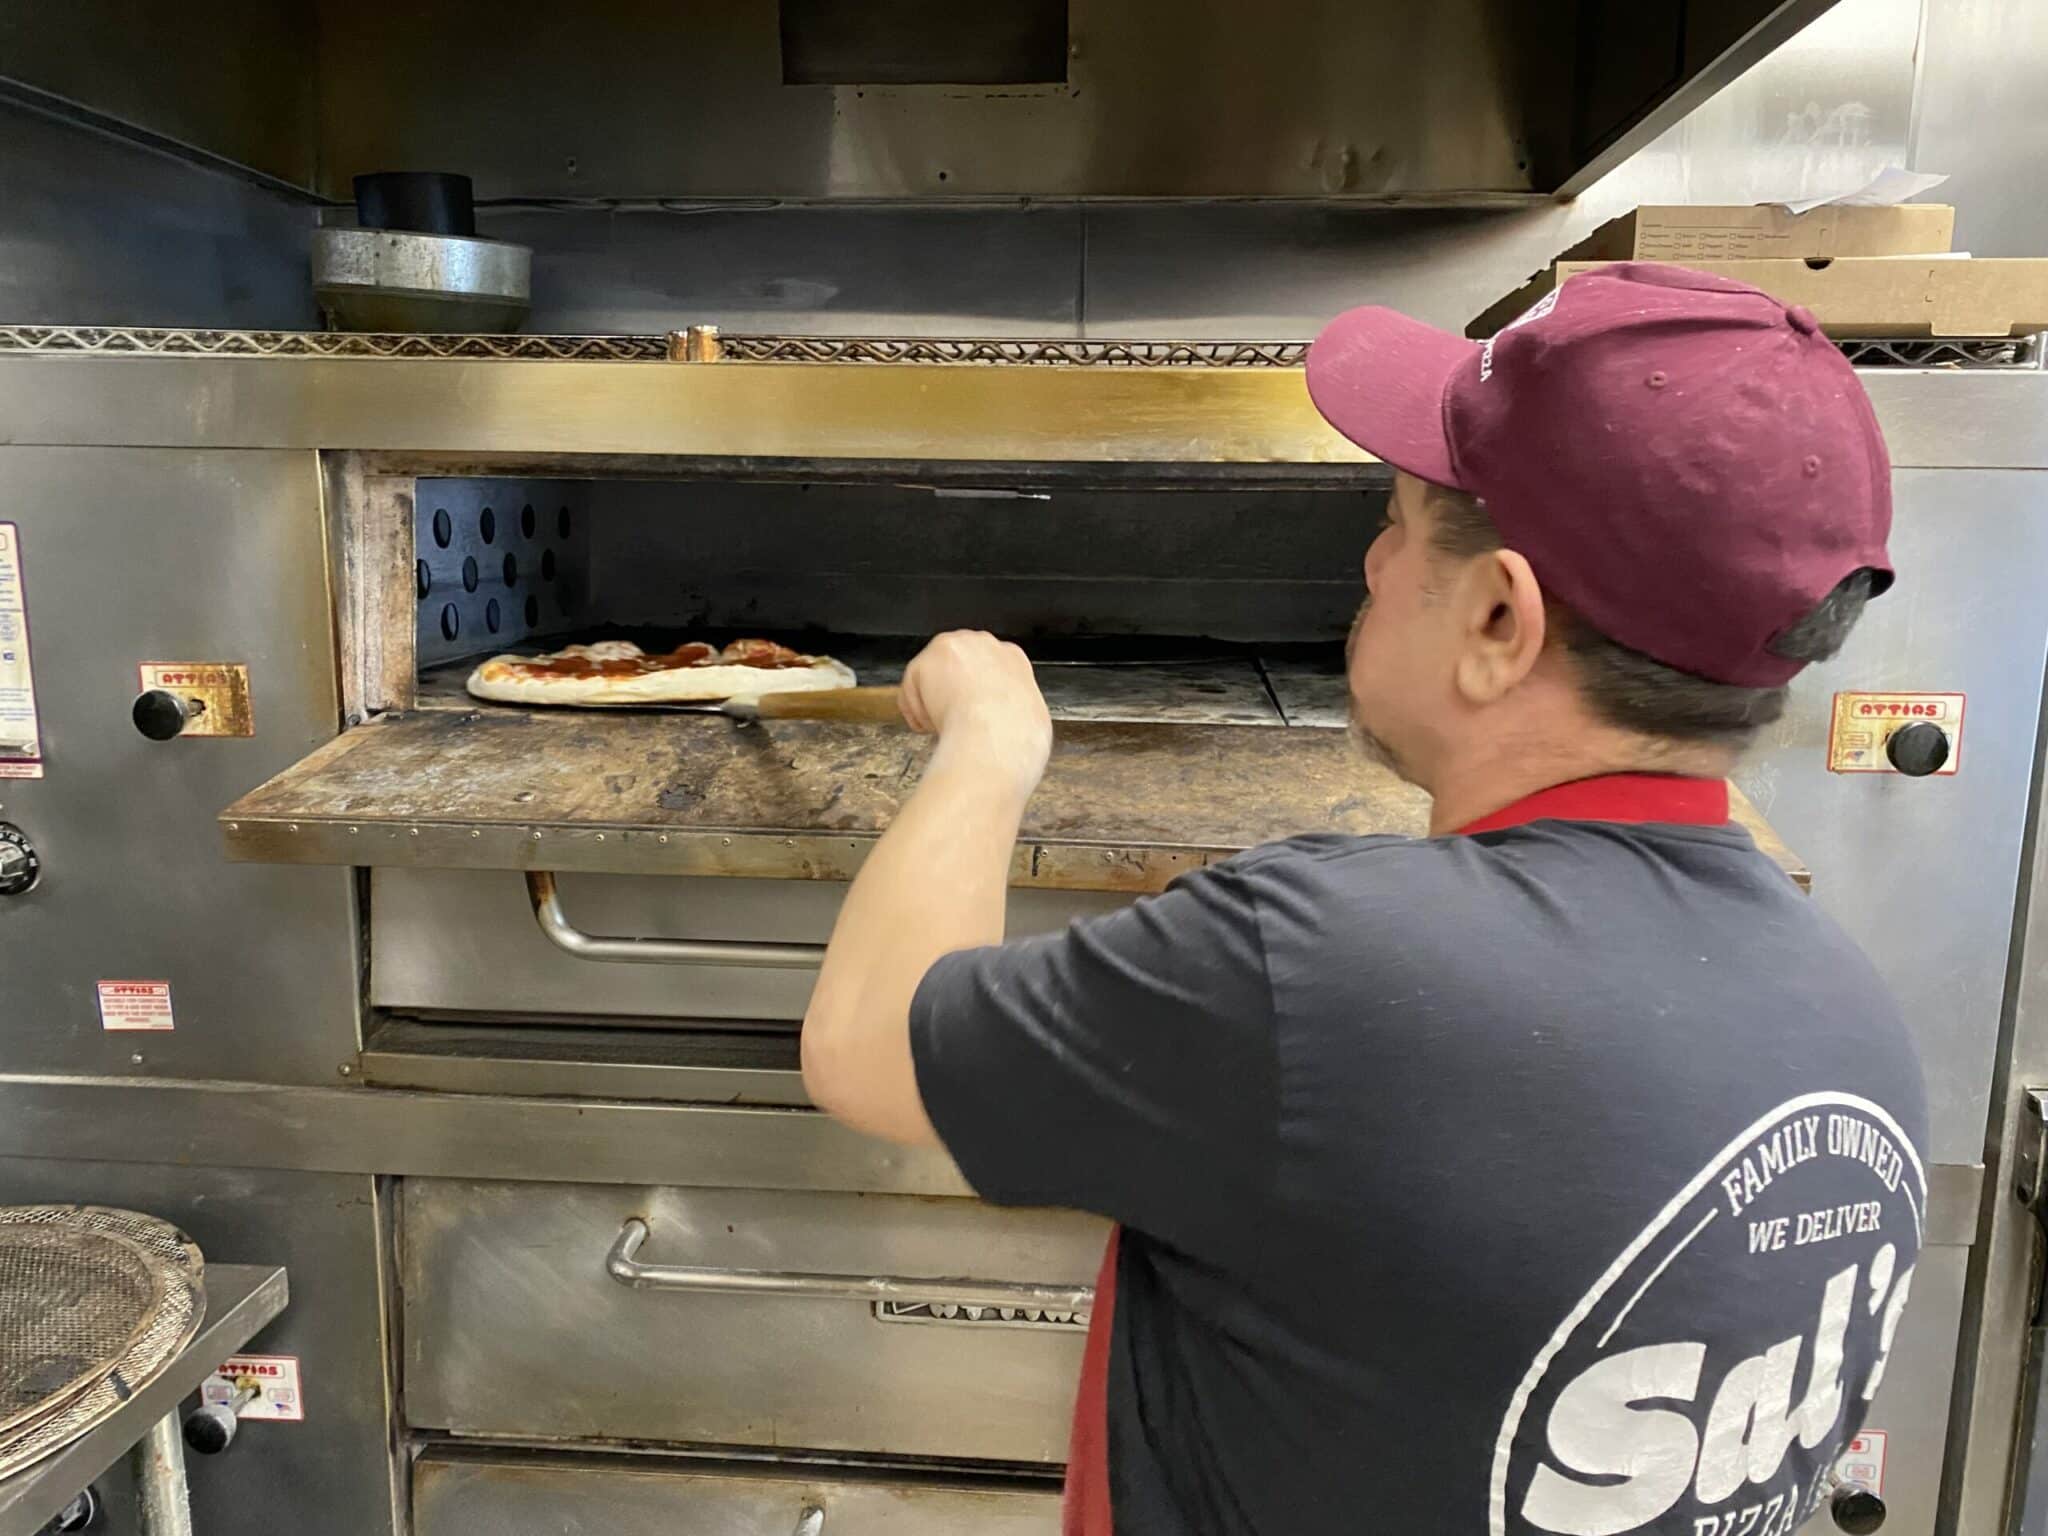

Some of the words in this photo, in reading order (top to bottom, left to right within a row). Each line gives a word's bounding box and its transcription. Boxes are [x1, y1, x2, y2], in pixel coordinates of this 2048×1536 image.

[162, 672, 228, 685] ATTAS
[1721, 1116, 1820, 1217] FAMILY
[1827, 1114, 1903, 1193] OWNED
[1748, 1217, 1790, 1254] WE
[1794, 1201, 1881, 1245] DELIVER
